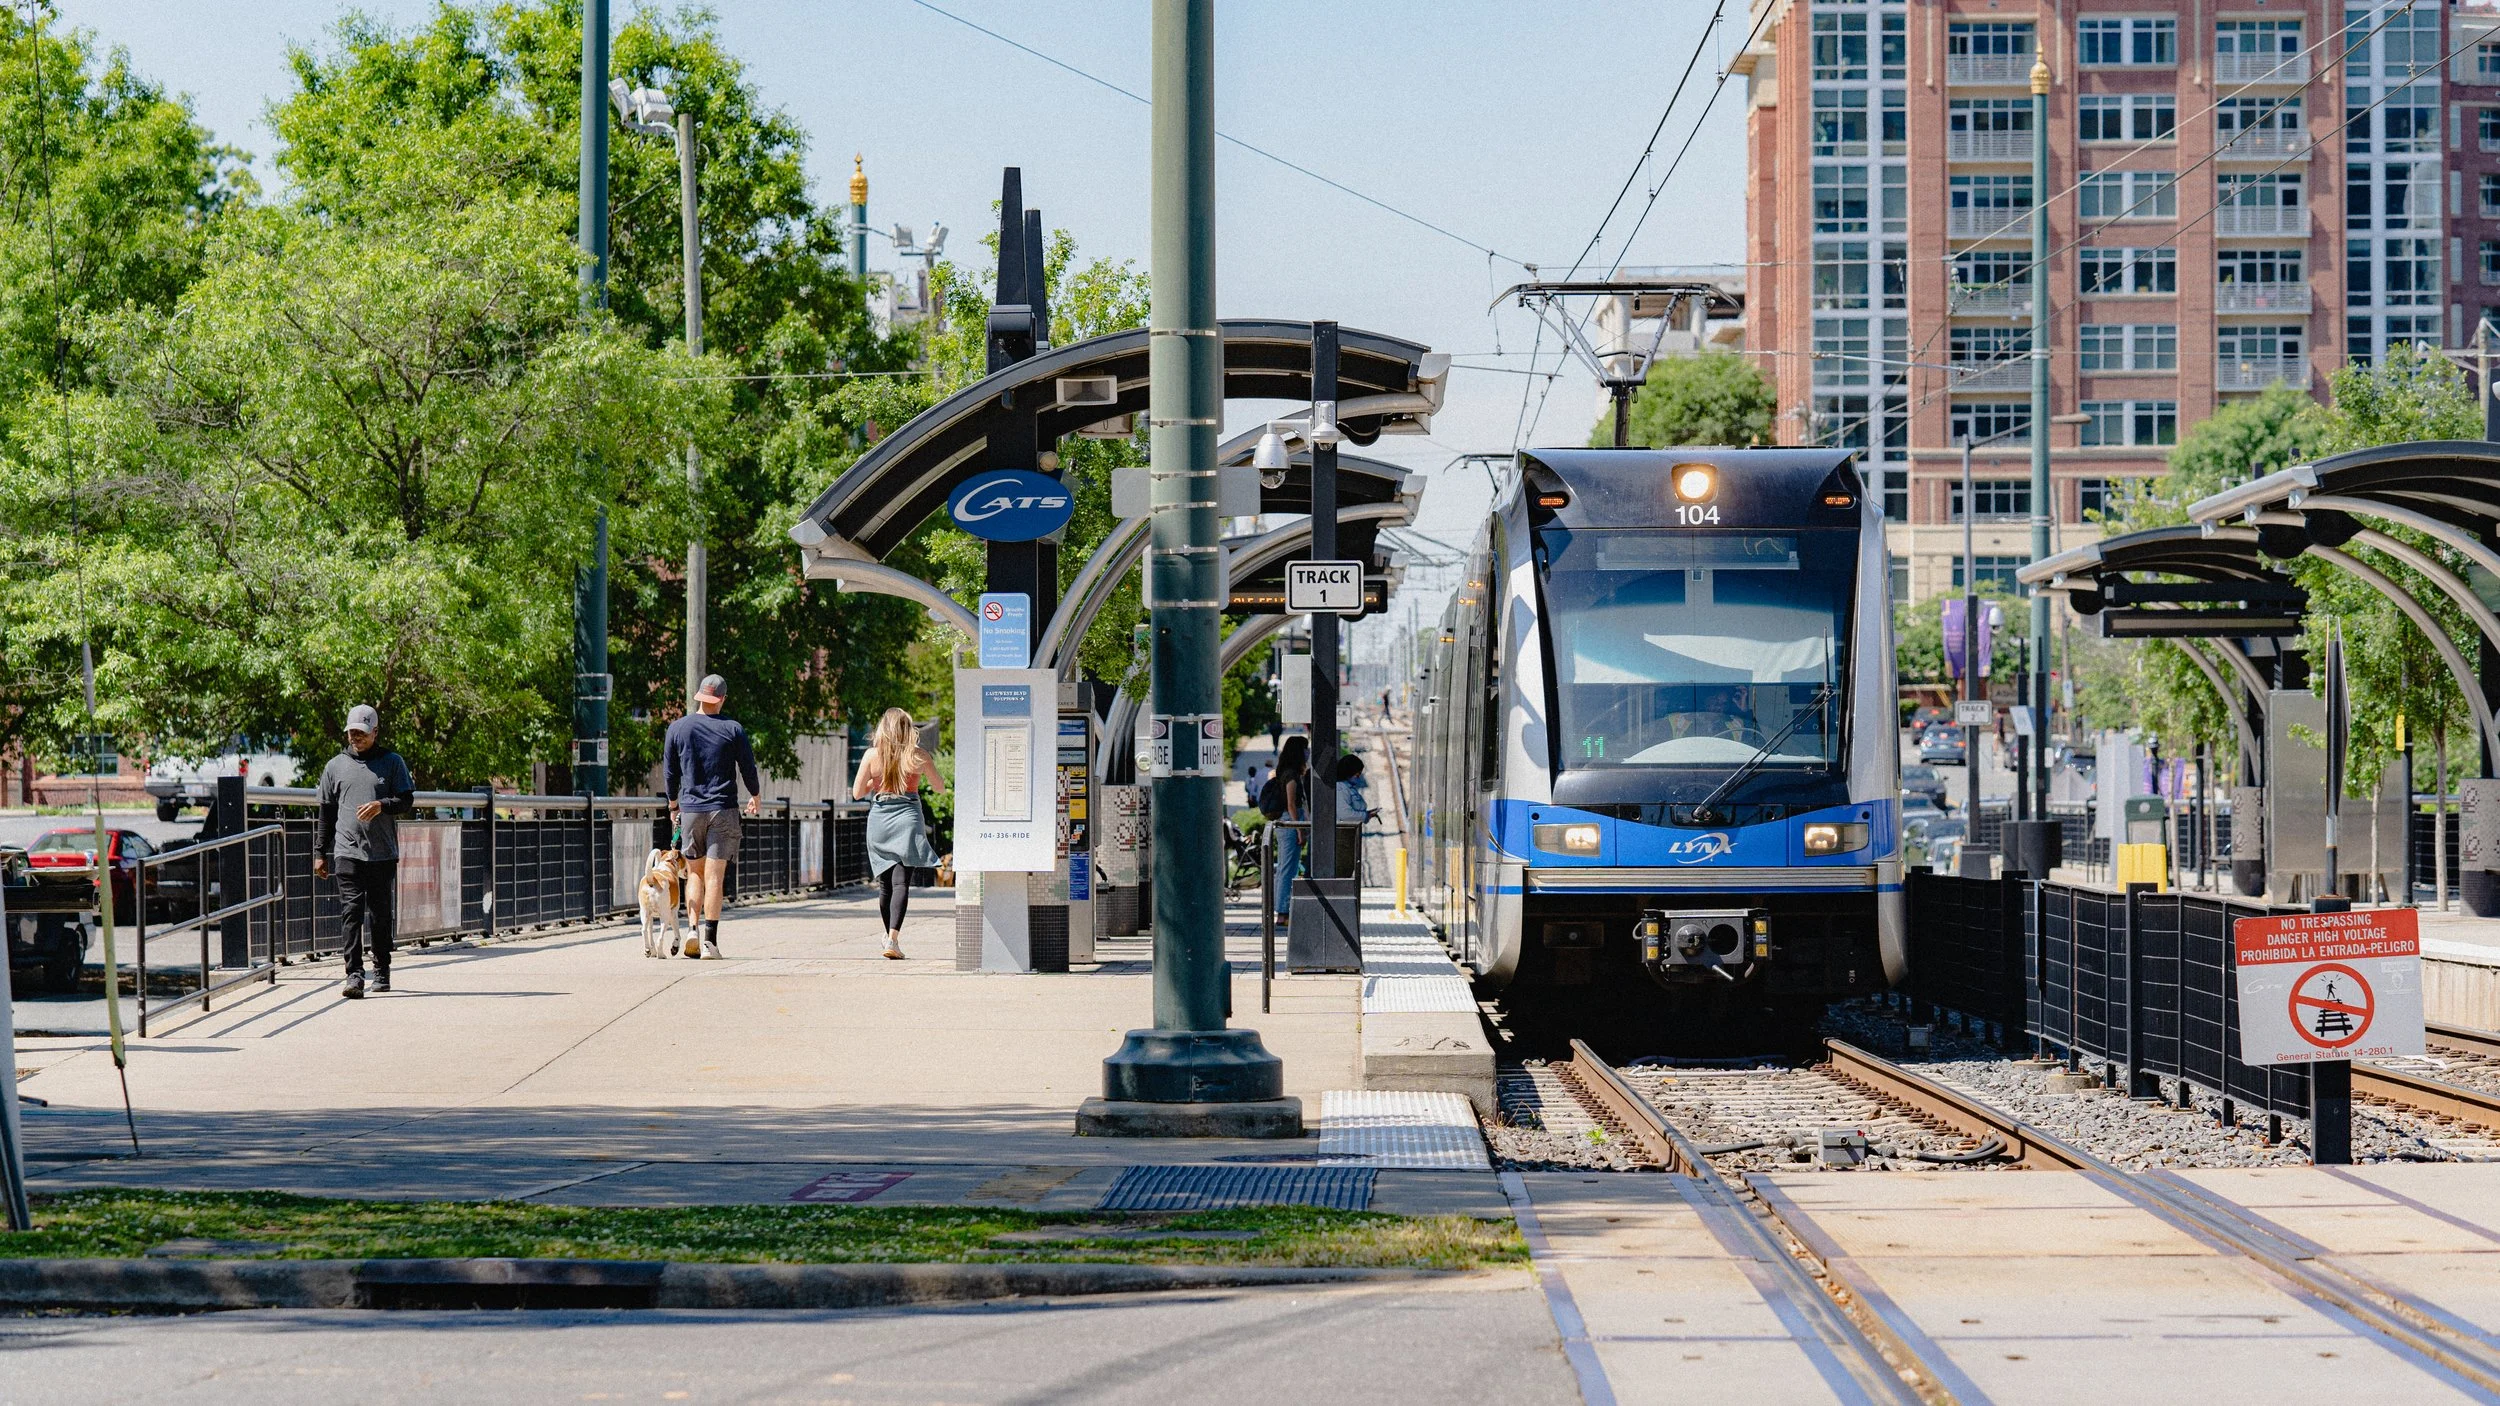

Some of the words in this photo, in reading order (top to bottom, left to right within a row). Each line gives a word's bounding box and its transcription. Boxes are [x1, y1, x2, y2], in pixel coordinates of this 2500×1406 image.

[954, 479, 1067, 522] CATS
[1675, 505, 1720, 525] 104
[1297, 570, 1350, 584] TRACK
[1319, 589, 1327, 603] 1
[995, 627, 1025, 635] Smoking
[1582, 736, 1604, 758] 11
[1668, 832, 1739, 865] LYNX
[2281, 918, 2296, 930] NO
[2301, 914, 2372, 929] TRESPASSING
[2267, 931, 2309, 946] DANGER
[2314, 930, 2339, 942] HIGH
[2344, 927, 2387, 940] VOLTAGE
[2241, 947, 2297, 962] PROHIBIDA
[2302, 946, 2315, 958] LA
[2276, 1051, 2311, 1062] General
[2315, 1049, 2350, 1060] Statute
[2354, 1046, 2393, 1057] 14-280.1
